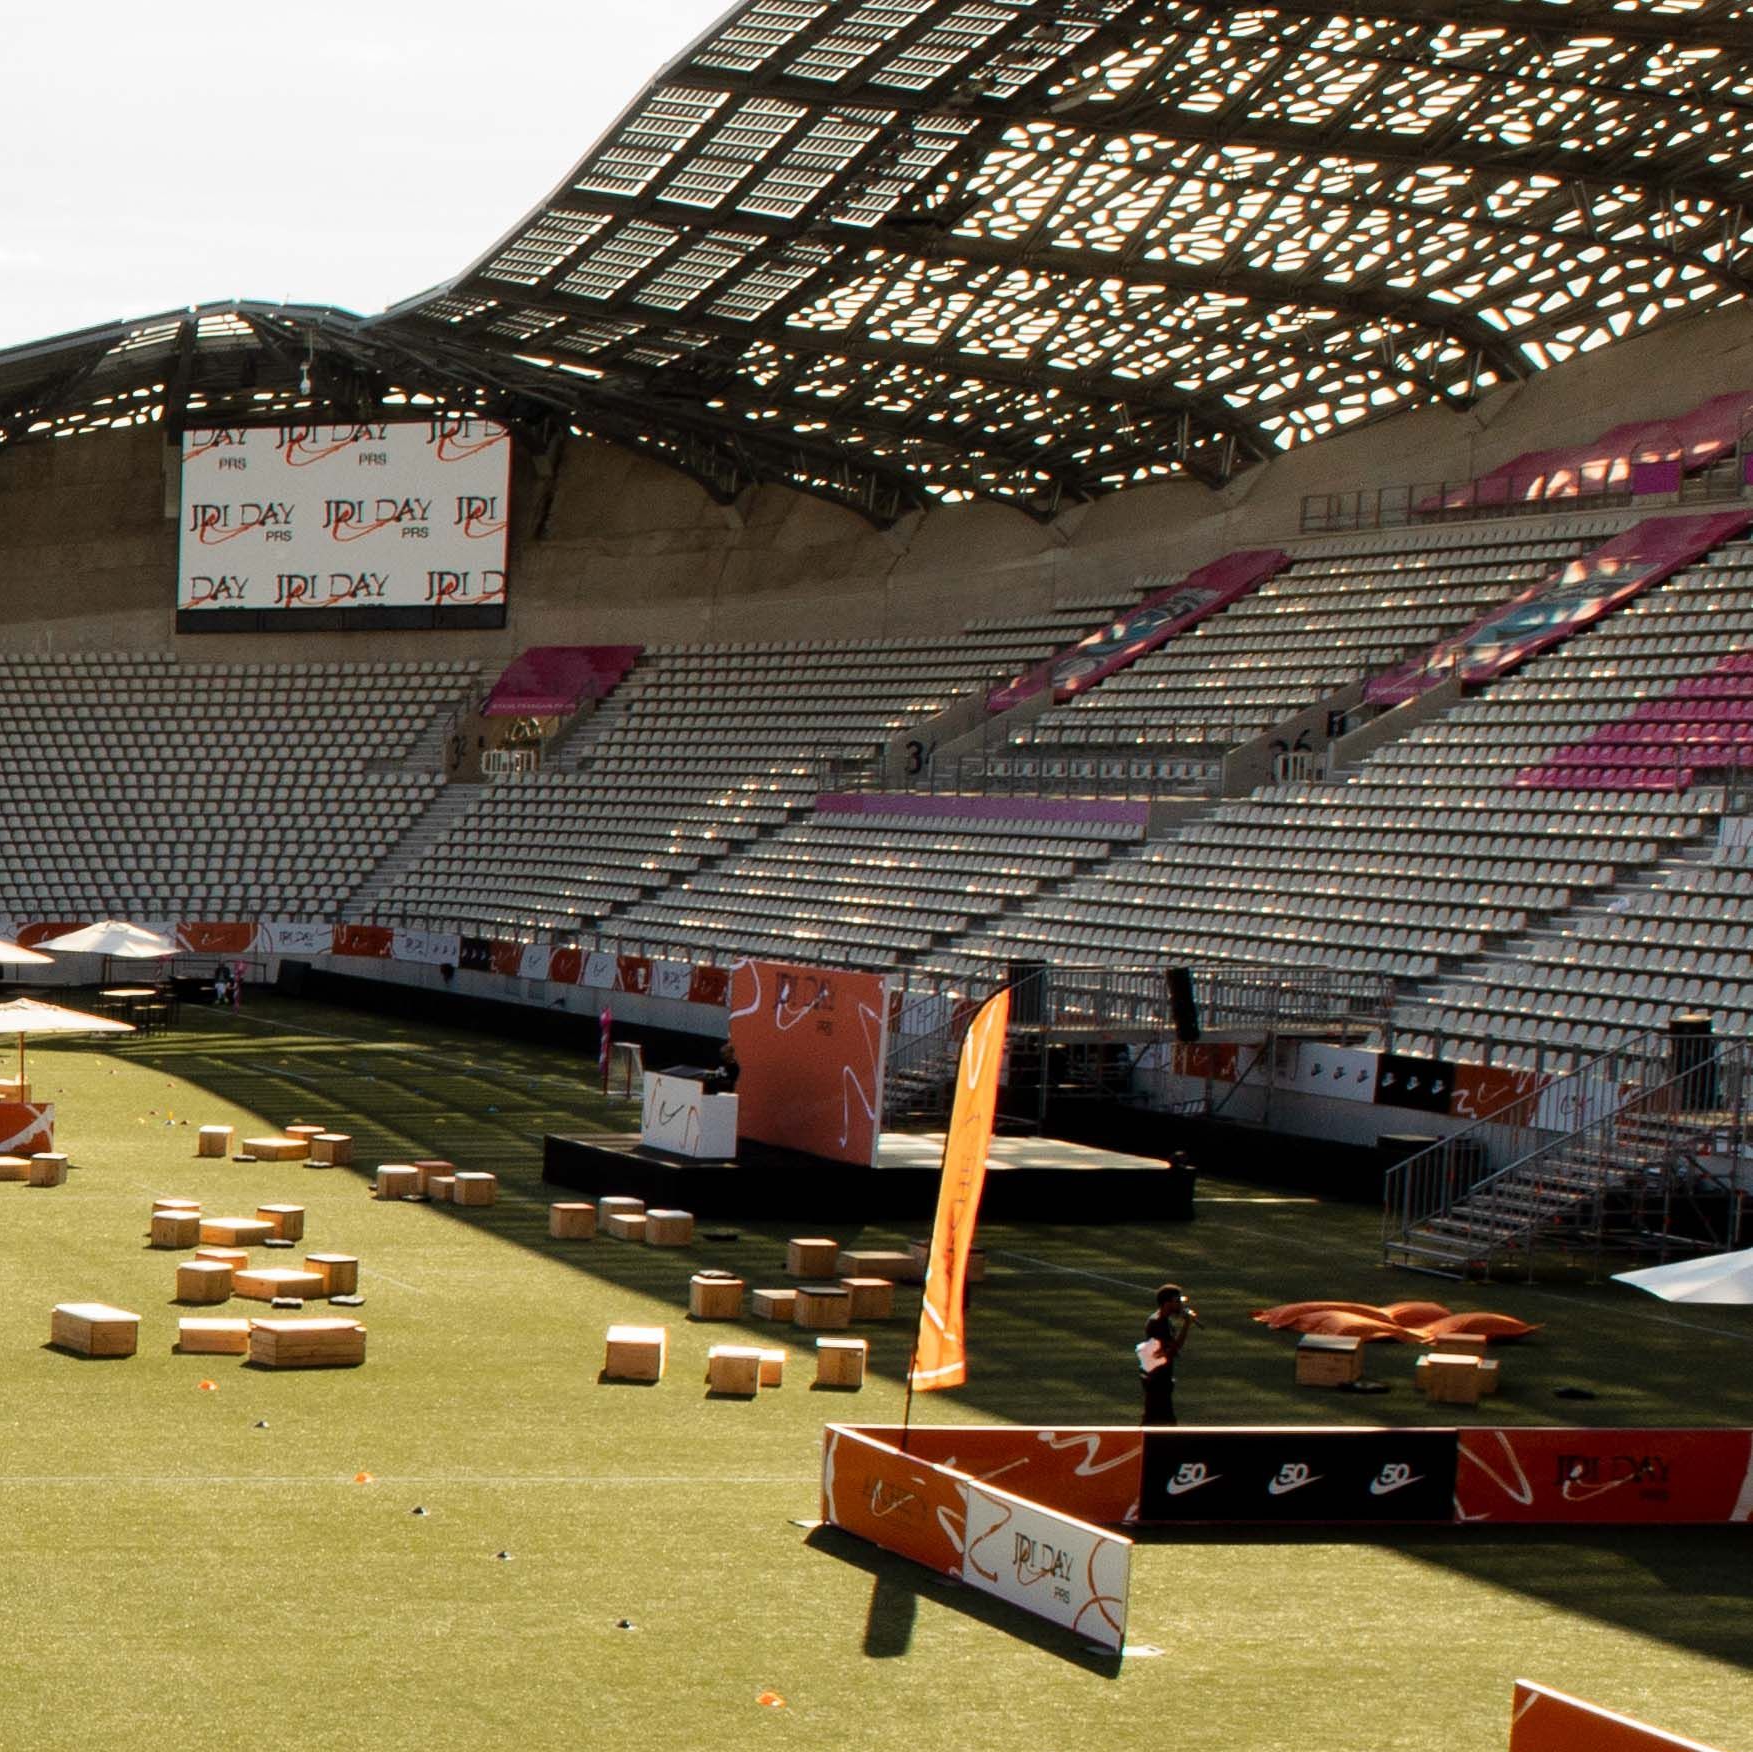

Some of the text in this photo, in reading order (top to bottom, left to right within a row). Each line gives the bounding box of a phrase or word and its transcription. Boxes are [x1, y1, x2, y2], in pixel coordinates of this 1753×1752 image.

[219, 457, 247, 470] PRS
[359, 453, 387, 466] PRS
[190, 503, 296, 531] JDI DAY
[322, 498, 432, 528] JDI DAY
[453, 496, 496, 524] JDI
[266, 529, 292, 542] PRS
[402, 526, 428, 539] PRS
[191, 576, 248, 600] DAY
[274, 573, 389, 603] JDI DAY
[424, 571, 469, 601] JDI
[1177, 1463, 1410, 1485] 50 50 50
[1012, 1532, 1074, 1582] JDI DAY
[1053, 1585, 1071, 1604] PRS
